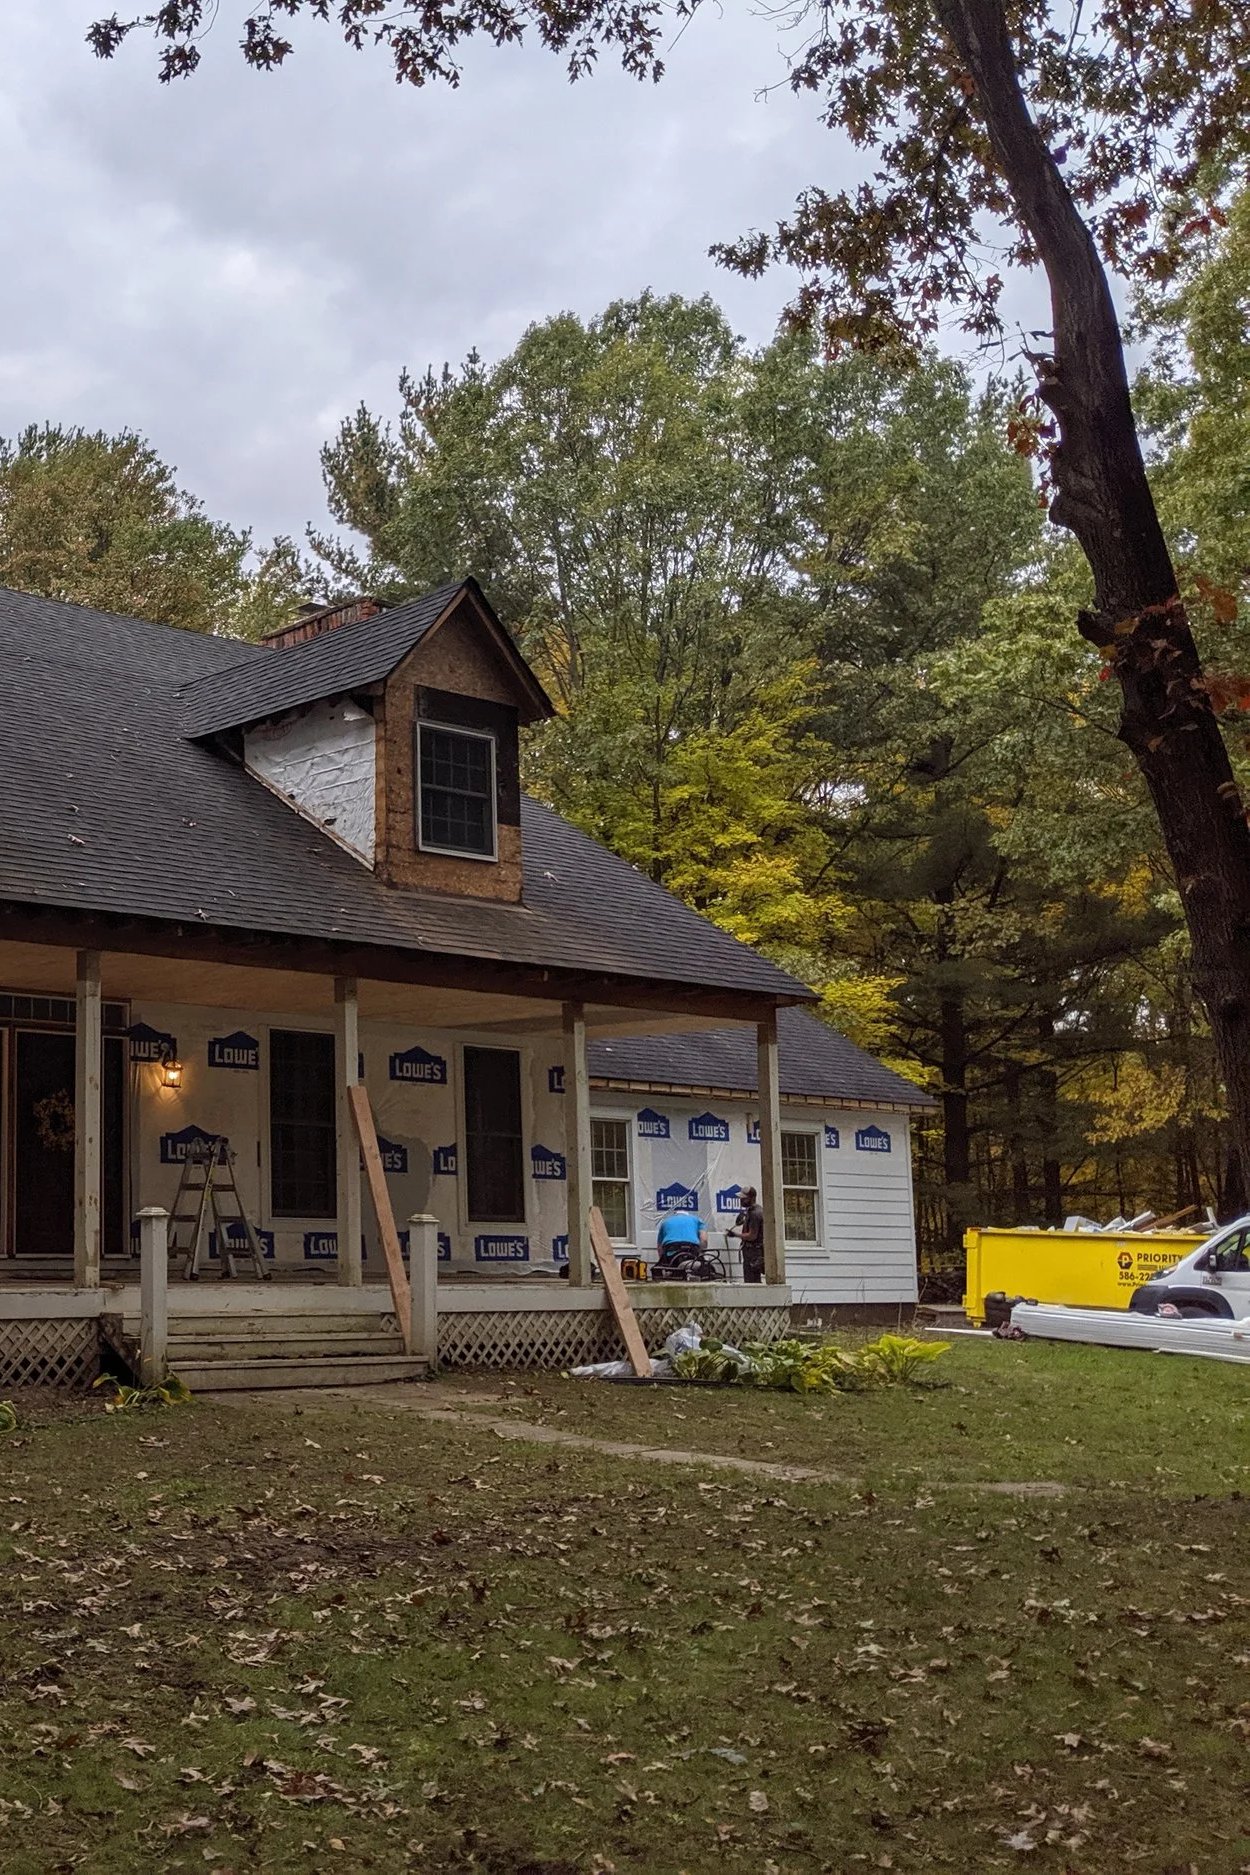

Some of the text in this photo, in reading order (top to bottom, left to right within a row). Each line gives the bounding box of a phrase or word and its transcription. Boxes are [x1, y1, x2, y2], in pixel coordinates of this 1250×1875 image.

[395, 1058, 441, 1080] LOWE'S
[692, 1122, 726, 1138] LOWE'S
[859, 1133, 888, 1150] LOWE'S
[382, 1150, 403, 1169] E'S
[532, 1158, 562, 1177] WE'S
[479, 1238, 524, 1258] LOWE'S
[1137, 1253, 1183, 1263] PRIORITY
[1119, 1271, 1154, 1281] 586-22
